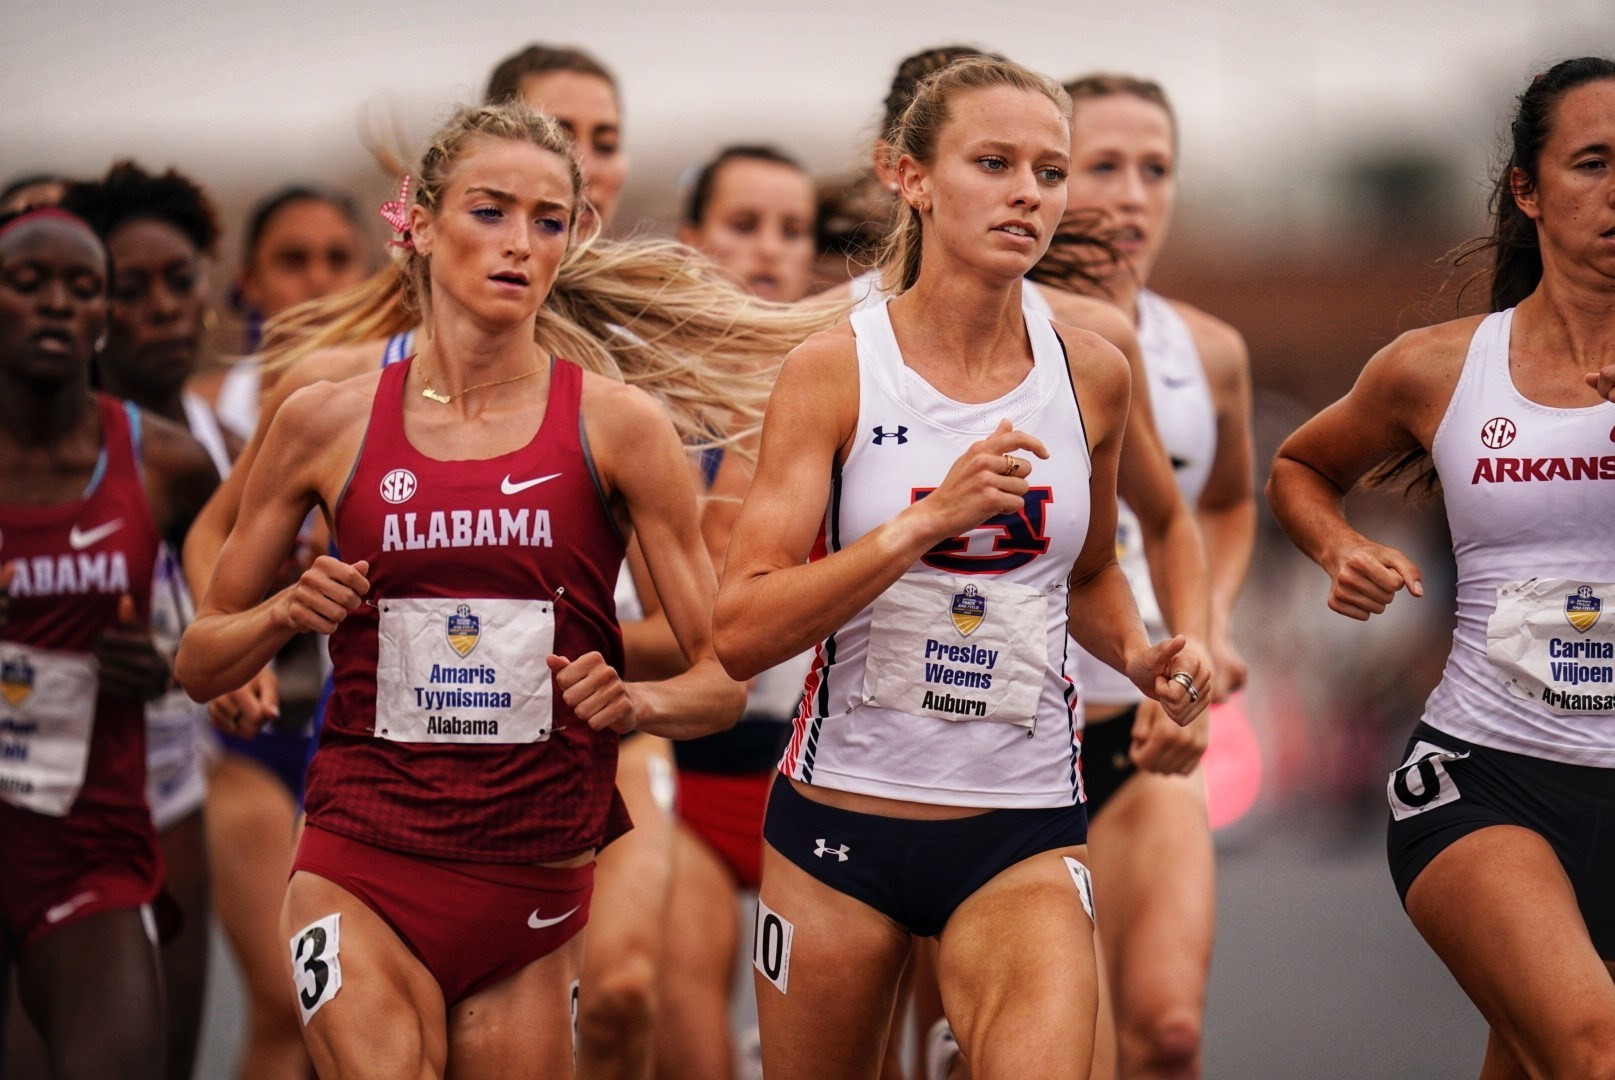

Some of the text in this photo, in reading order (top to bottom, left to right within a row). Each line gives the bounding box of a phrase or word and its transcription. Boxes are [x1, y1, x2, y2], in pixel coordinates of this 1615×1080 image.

[1482, 418, 1515, 449] SEC
[382, 470, 415, 502] SEC
[382, 508, 553, 552] ALABAMA
[9, 550, 129, 597] ABAMA
[925, 639, 998, 669] Presley
[1549, 638, 1613, 659] Carina
[430, 664, 496, 684] Amaris
[925, 663, 992, 689] Weems
[1550, 662, 1613, 685] Viljoen
[414, 687, 512, 710] Tyynismaa
[922, 691, 987, 717] Auburn
[427, 716, 498, 735] Alabama
[295, 927, 329, 1010] 3
